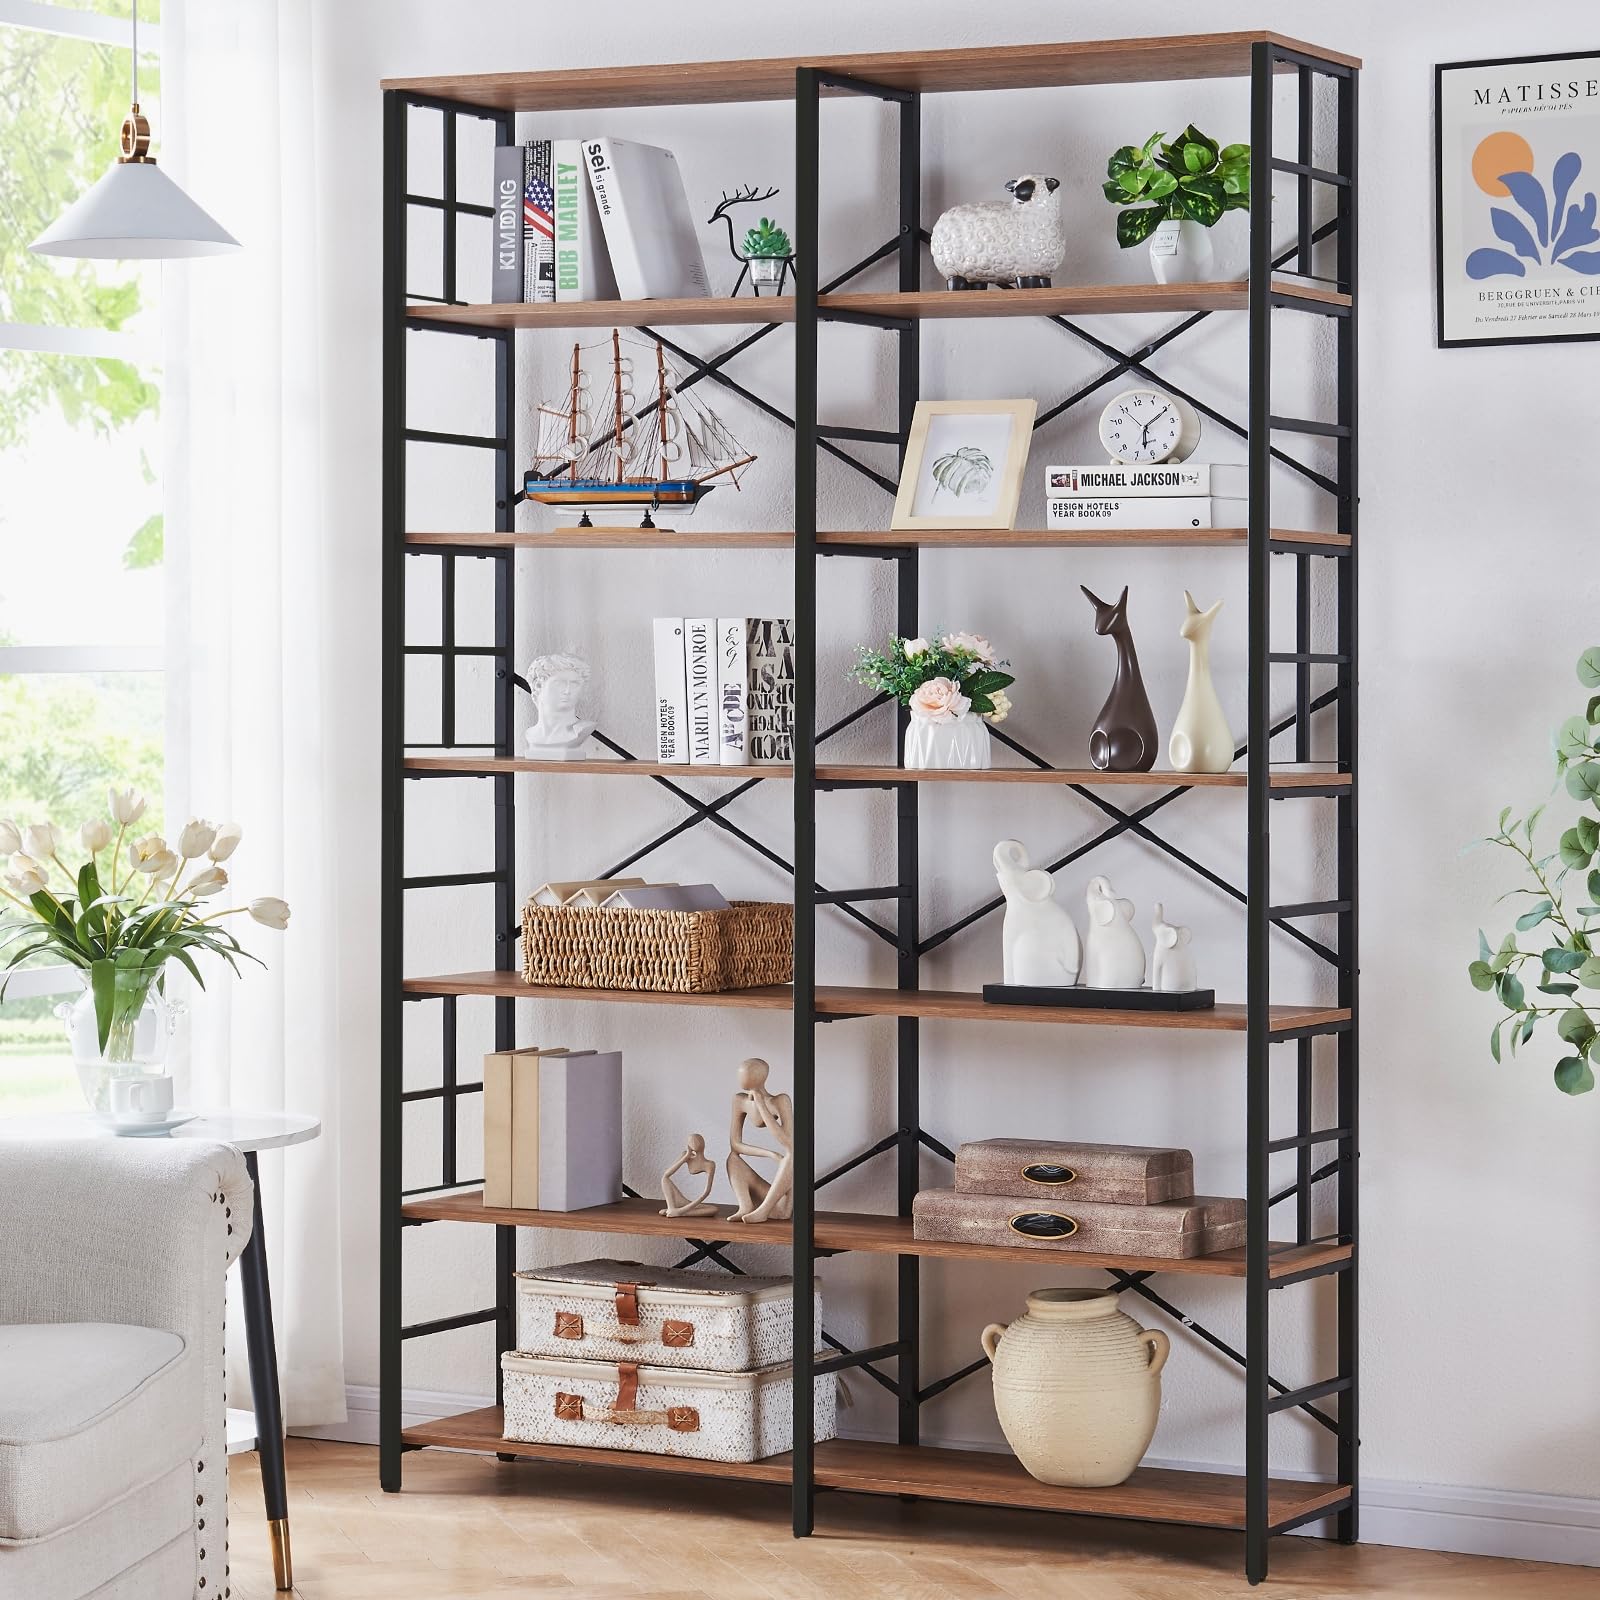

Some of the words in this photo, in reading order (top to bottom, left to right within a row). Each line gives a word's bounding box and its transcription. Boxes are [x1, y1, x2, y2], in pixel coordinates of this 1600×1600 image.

[1473, 80, 1598, 105] MATISSE
[588, 143, 610, 174] sei
[557, 162, 578, 240] MARLEY
[595, 184, 611, 216] grande
[558, 250, 579, 290] BOB
[1479, 288, 1560, 302] BERGGRUEN
[1566, 287, 1574, 297] &
[1133, 399, 1142, 407] 12
[1114, 418, 1123, 426] 10
[1122, 443, 1128, 451] 8
[1150, 449, 1156, 457] 6
[1080, 473, 1128, 487] MICHAEL
[1130, 472, 1180, 486] JACKSON
[1052, 502, 1084, 511] DESIGN
[1086, 502, 1120, 510] HOTELS
[1052, 510, 1075, 518] YEAR
[691, 624, 709, 687] MONROE
[660, 698, 668, 728] HOTELS
[693, 692, 709, 759] MARILYN
[660, 730, 668, 759] DESIGN
[667, 738, 676, 759] YEAR
